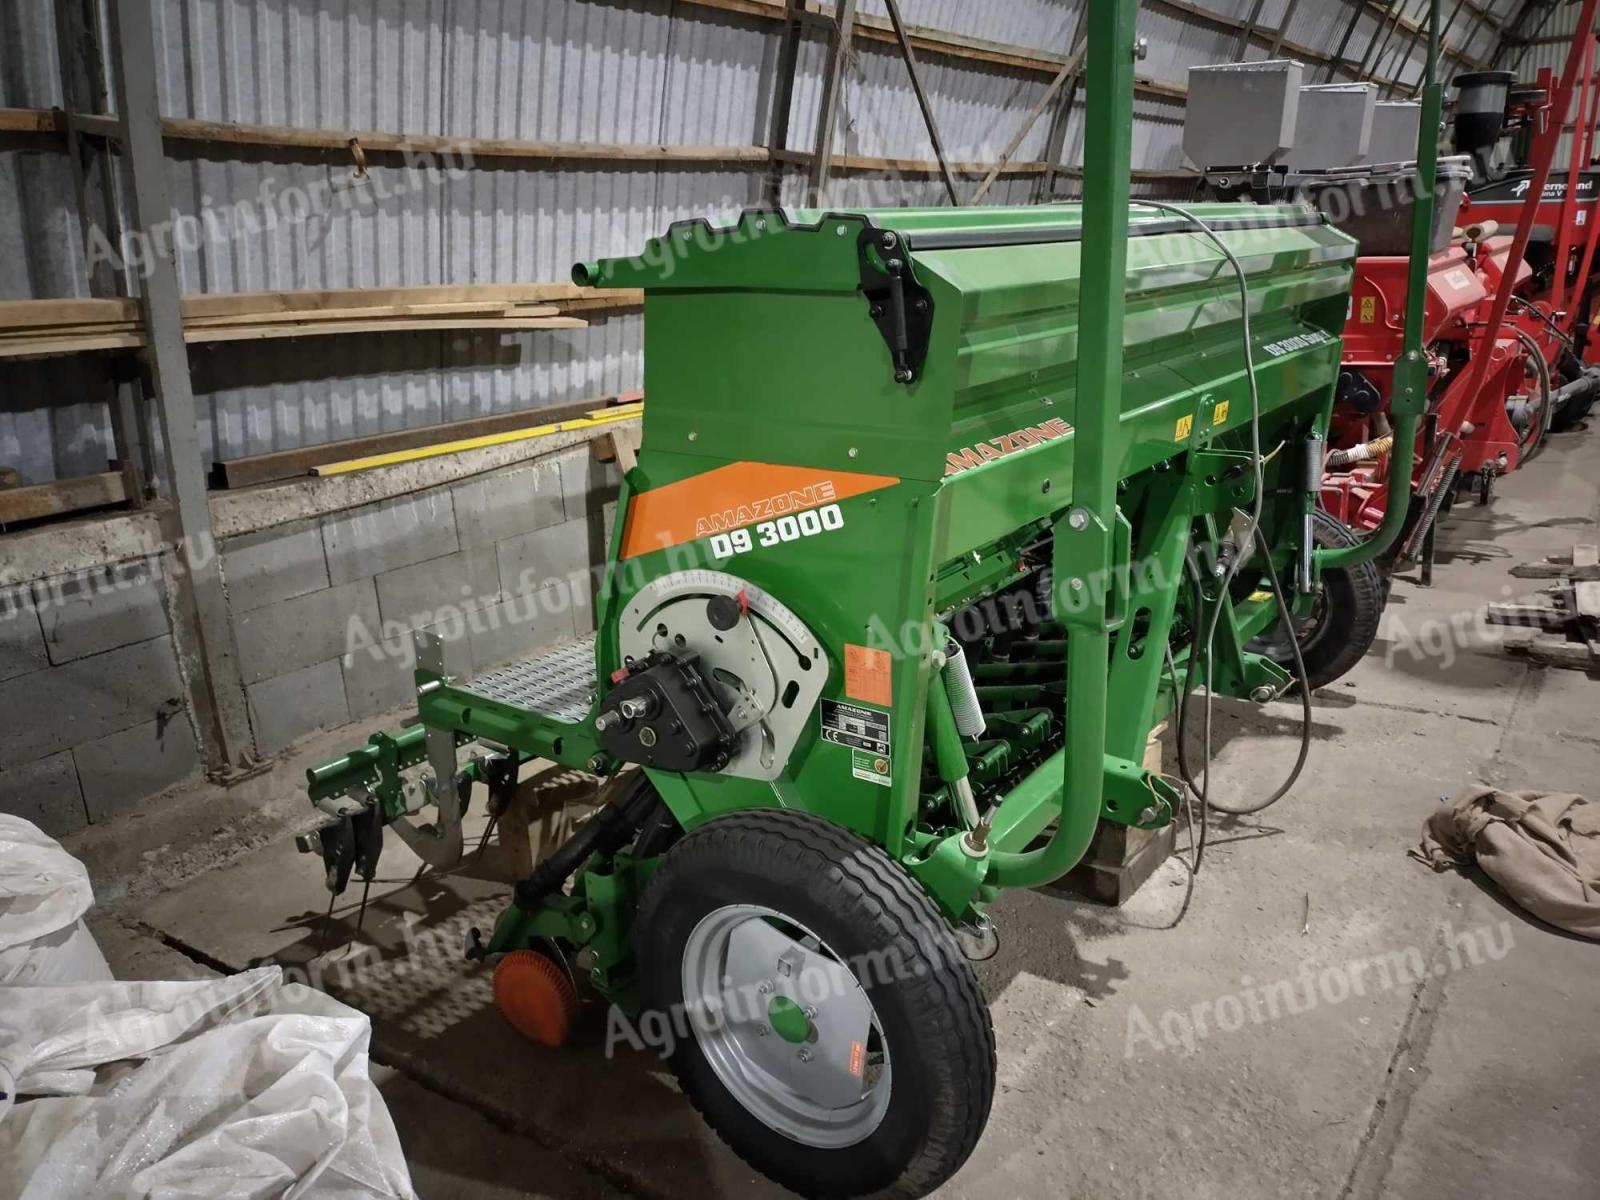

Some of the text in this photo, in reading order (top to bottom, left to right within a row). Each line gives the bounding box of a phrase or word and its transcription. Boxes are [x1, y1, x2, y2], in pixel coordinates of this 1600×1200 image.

[695, 480, 836, 537] AMAZONE
[710, 503, 845, 559] D9 3000
